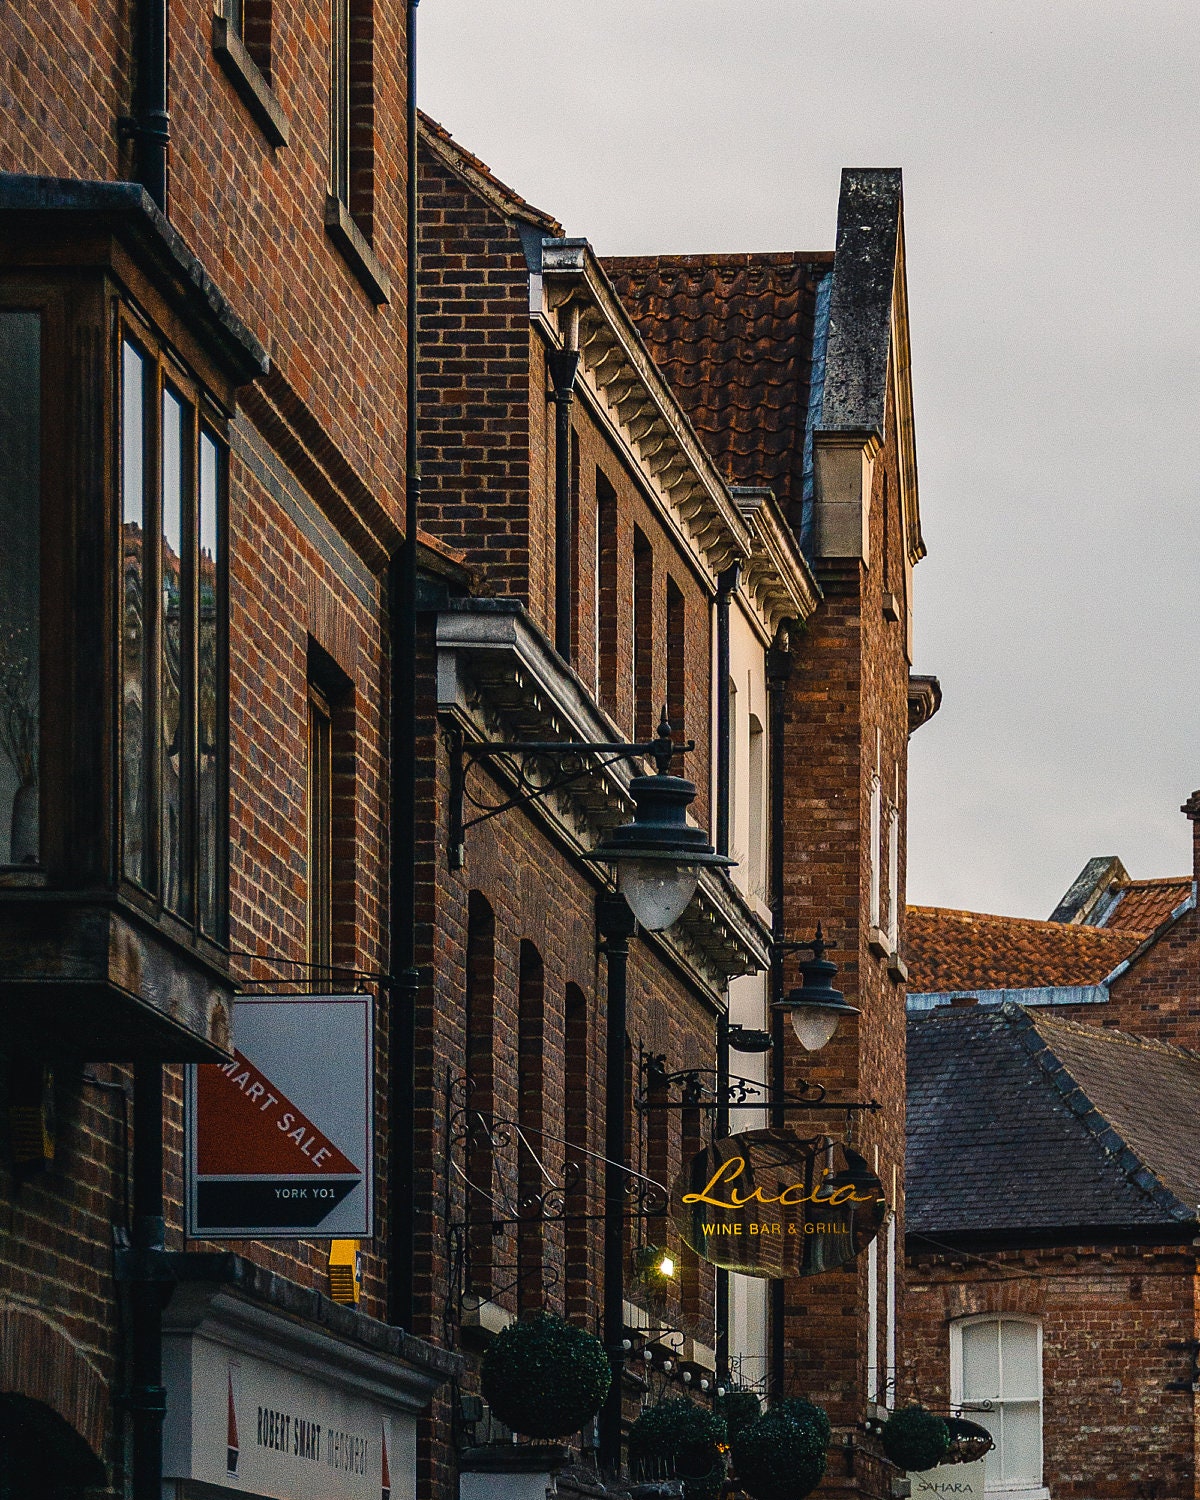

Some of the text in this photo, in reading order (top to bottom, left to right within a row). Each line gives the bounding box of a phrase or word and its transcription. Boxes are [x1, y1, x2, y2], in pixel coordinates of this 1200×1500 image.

[276, 1112, 333, 1168] SALE
[275, 1188, 308, 1199] YORK
[682, 1156, 873, 1209] Lucia
[701, 1222, 849, 1237] WINE BAR & GRILL
[257, 1406, 291, 1454] ROBERT
[294, 1417, 321, 1462] SMART
[917, 1481, 974, 1493] SAHARA
